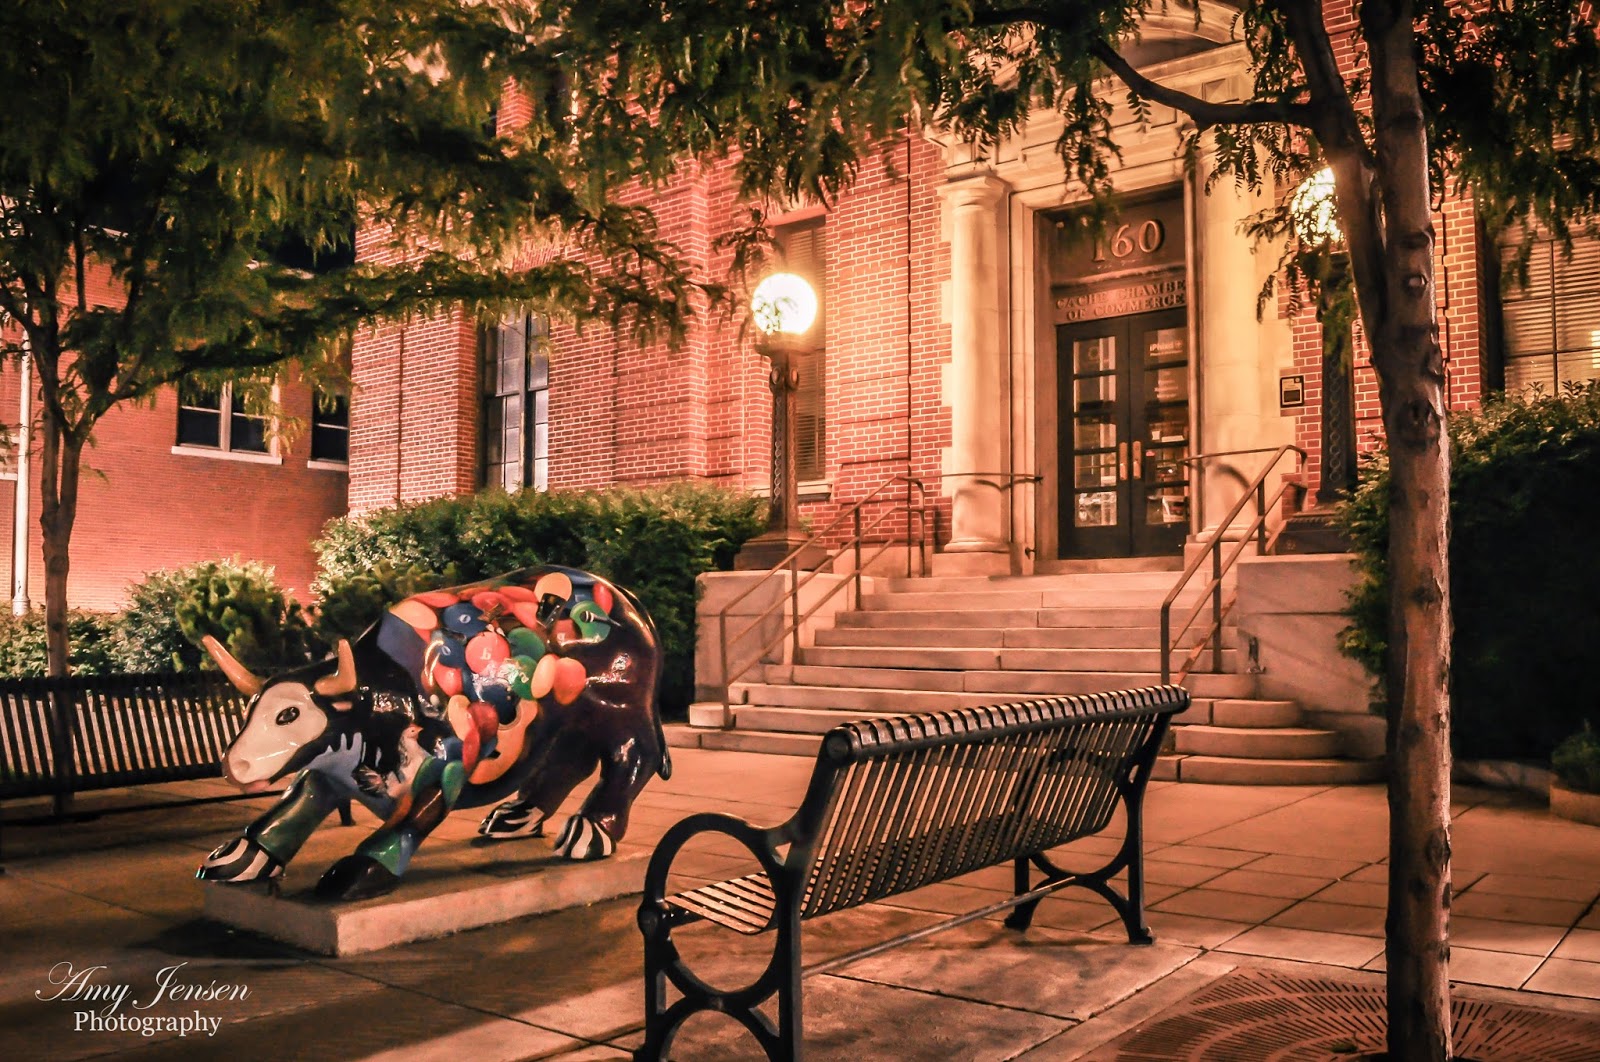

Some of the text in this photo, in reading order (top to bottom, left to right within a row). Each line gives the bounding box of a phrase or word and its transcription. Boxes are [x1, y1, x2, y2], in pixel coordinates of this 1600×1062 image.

[1093, 220, 1164, 262] 160
[1056, 280, 1186, 310] CACHE CHAMBE
[1066, 293, 1186, 321] OF COMMERCE
